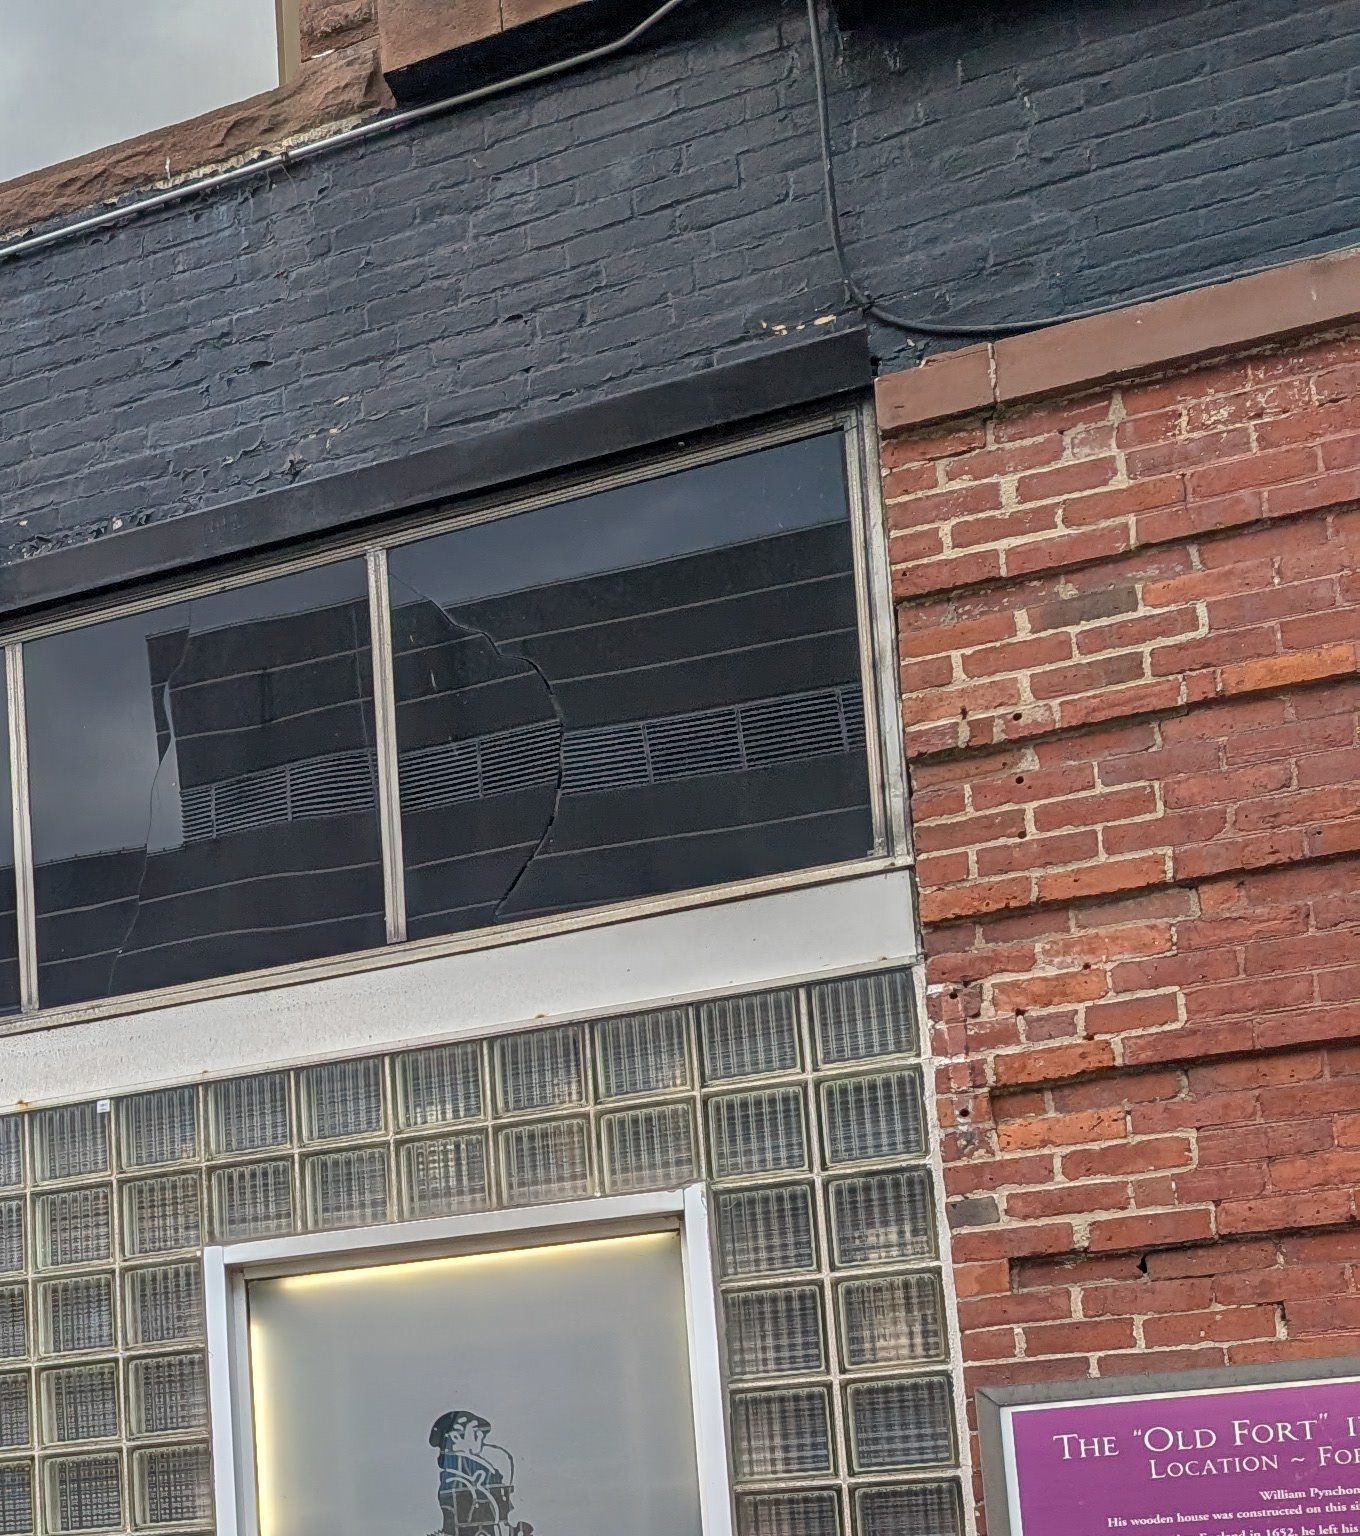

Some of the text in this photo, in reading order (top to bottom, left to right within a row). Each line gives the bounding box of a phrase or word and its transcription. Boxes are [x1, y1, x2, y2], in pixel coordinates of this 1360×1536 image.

[1053, 1433, 1120, 1460] THE
[1150, 1454, 1279, 1480] LOCATION
[1259, 1489, 1306, 1500] William
[1107, 1517, 1128, 1528] His
[1130, 1514, 1174, 1526] wooden
[1177, 1513, 1210, 1523] house
[1212, 1512, 1233, 1520] was
[1237, 1505, 1302, 1518] constructed
[1325, 1502, 1347, 1512] this
[1350, 1501, 1360, 1510] si
[1301, 1526, 1315, 1536] he
[1319, 1524, 1338, 1534] left
[1341, 1524, 1358, 1533] his
